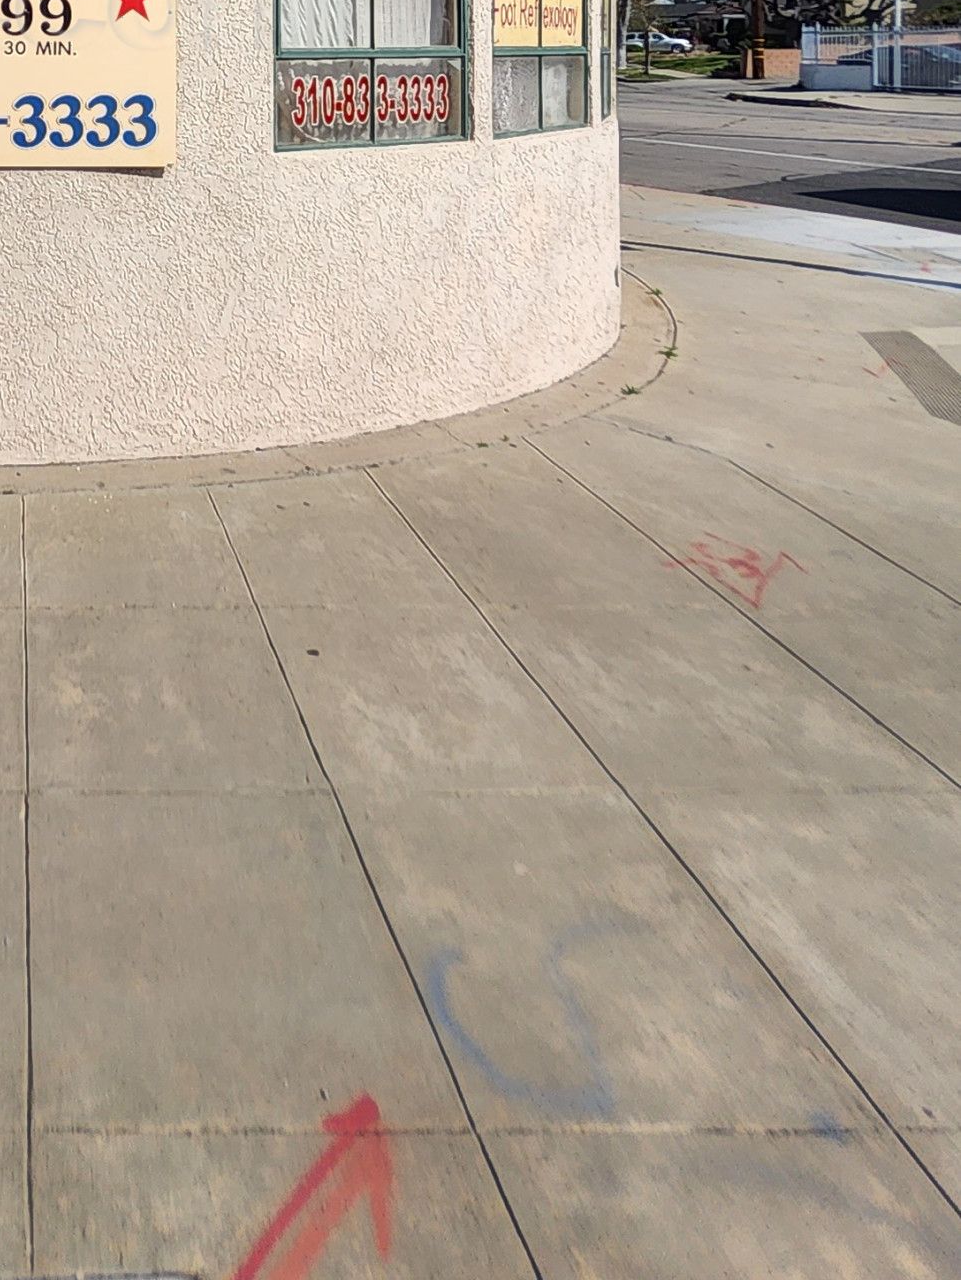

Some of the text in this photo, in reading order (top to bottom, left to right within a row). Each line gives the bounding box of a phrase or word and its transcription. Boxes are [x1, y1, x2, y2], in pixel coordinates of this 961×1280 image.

[4, 41, 77, 56] 30 MIN.
[291, 74, 449, 127] 310-833-3333
